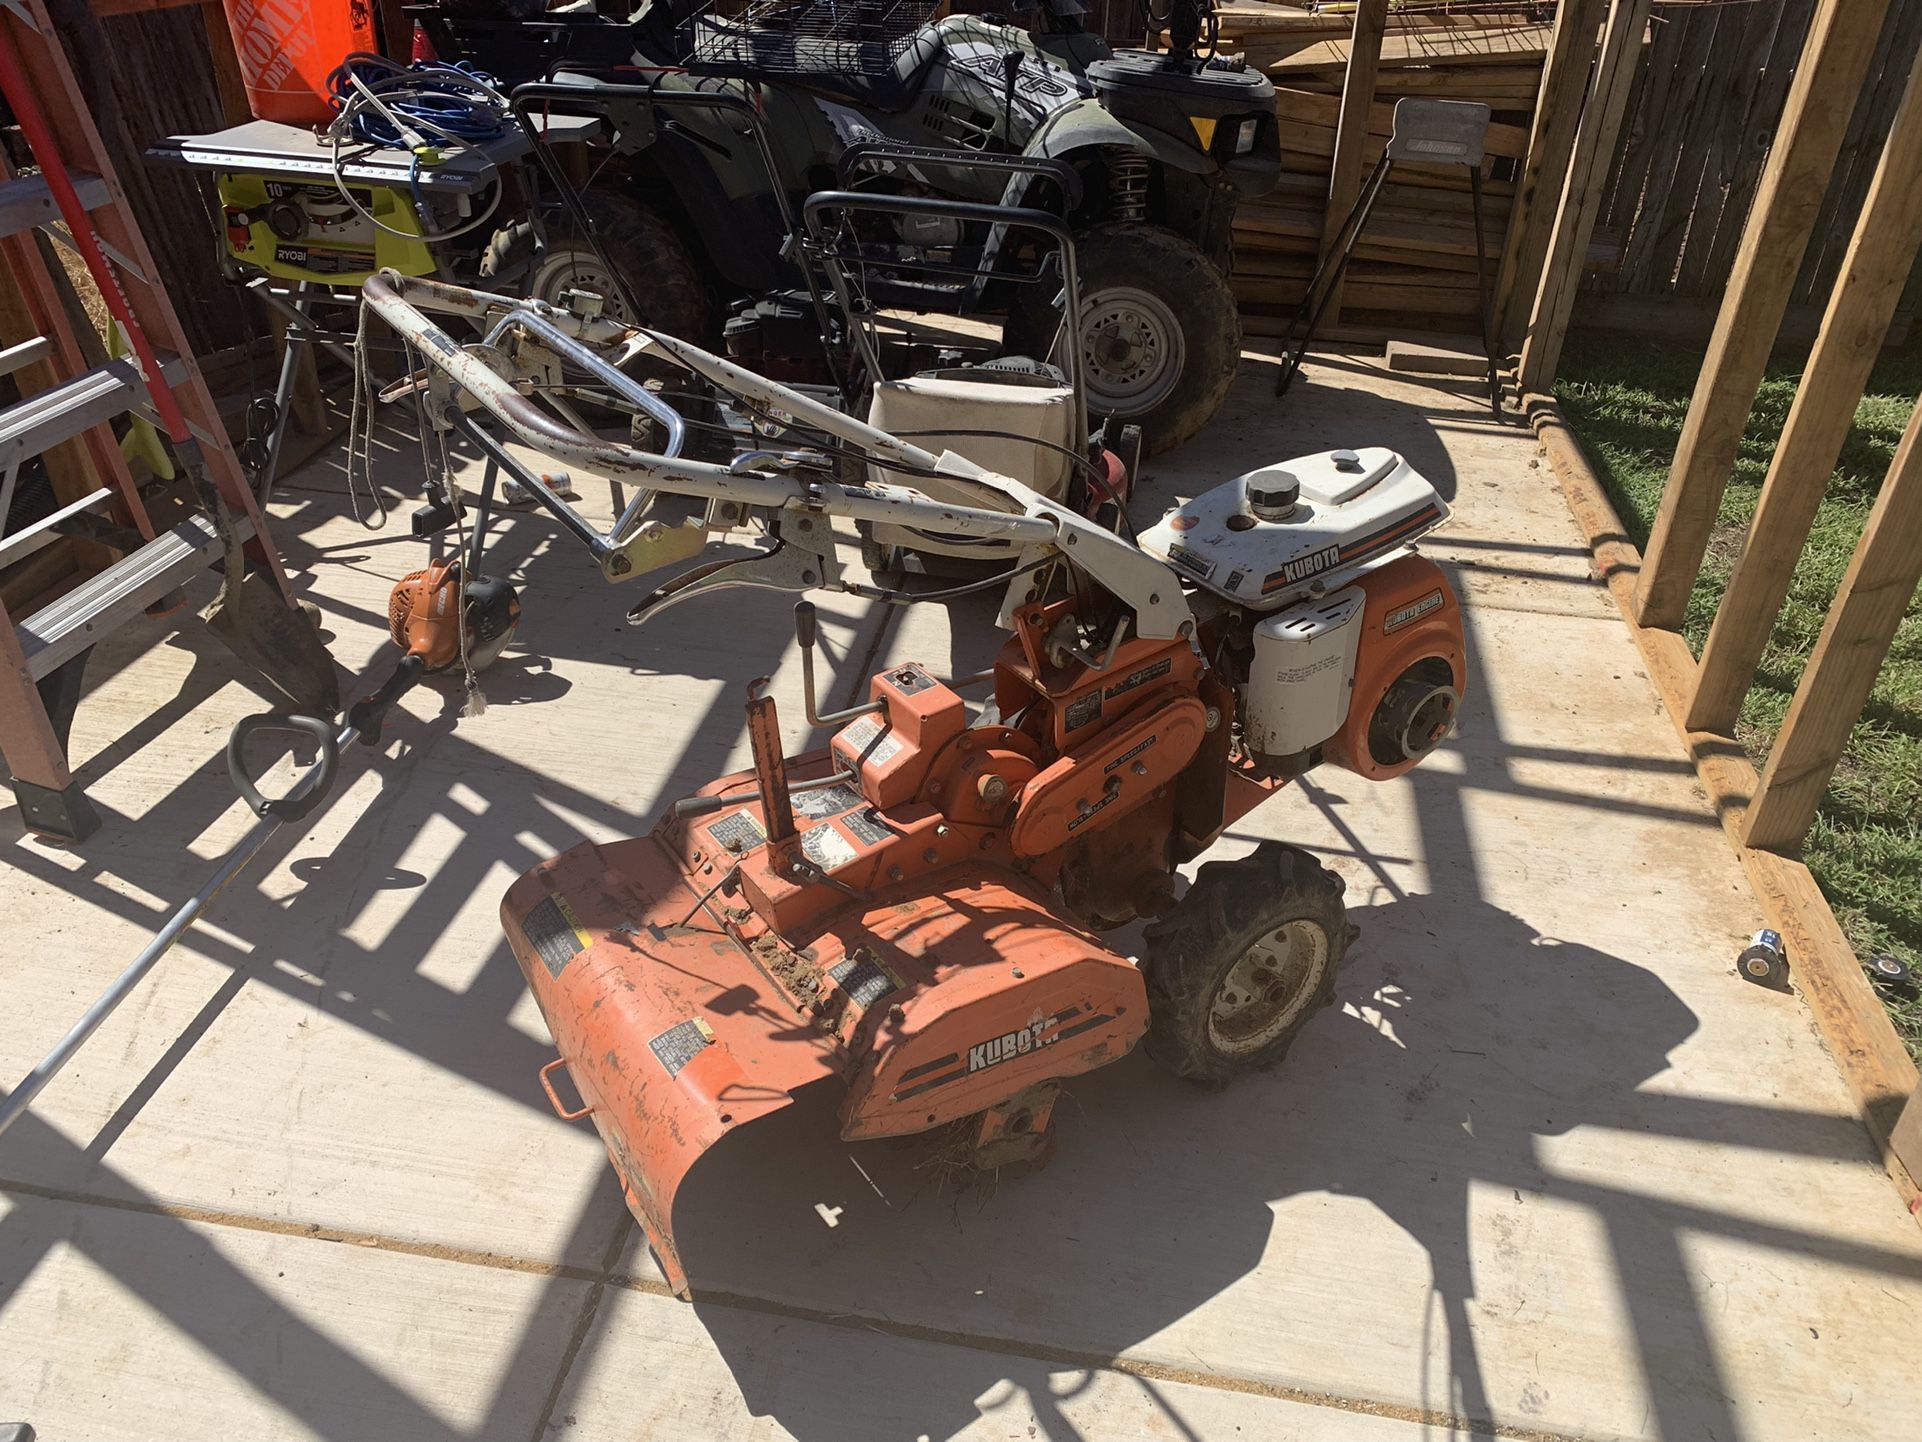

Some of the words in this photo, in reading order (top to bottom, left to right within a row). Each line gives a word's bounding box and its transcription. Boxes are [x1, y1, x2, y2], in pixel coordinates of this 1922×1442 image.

[1413, 140, 1462, 154] Johnson
[266, 183, 283, 197] 10
[278, 249, 307, 262] RYOBI
[1284, 546, 1340, 583] KUBOTA
[970, 1017, 1059, 1072] KUBOTA
